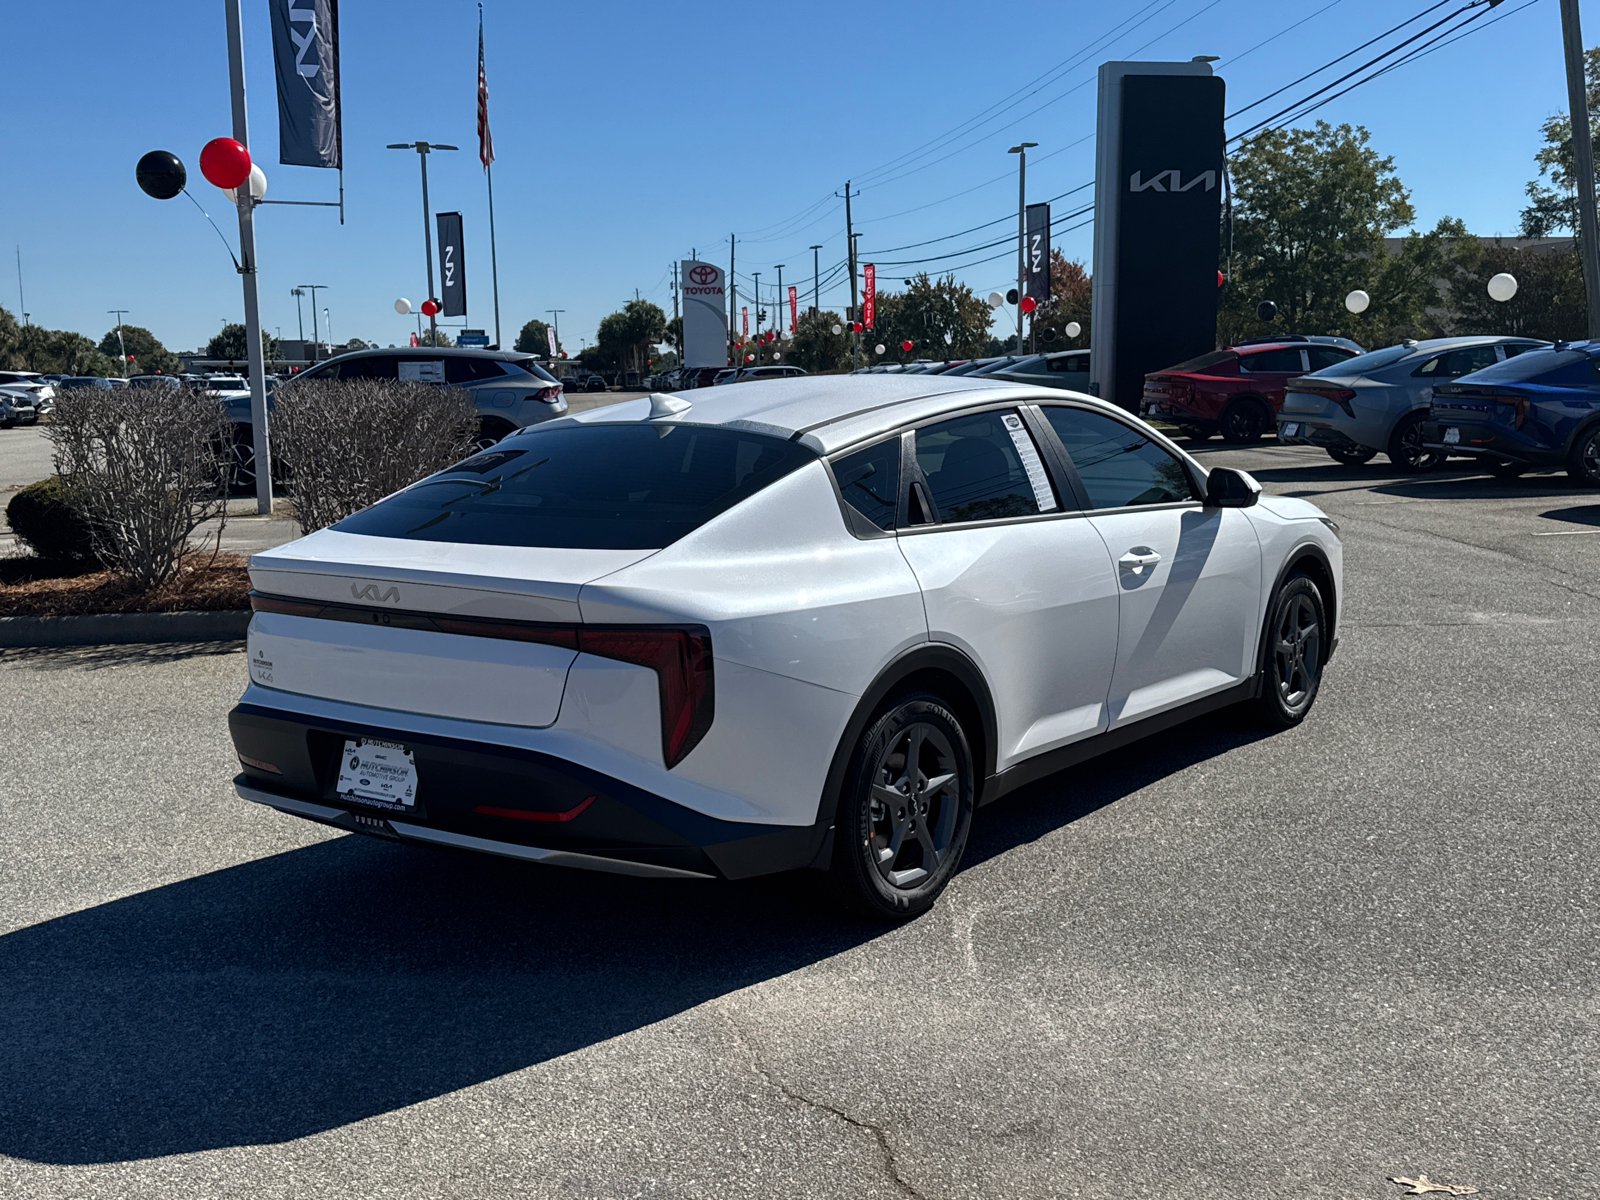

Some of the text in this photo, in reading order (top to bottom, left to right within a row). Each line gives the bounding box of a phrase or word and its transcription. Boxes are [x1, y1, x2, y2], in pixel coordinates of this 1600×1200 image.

[1130, 170, 1216, 192] KIA
[684, 287, 723, 295] TOYOTA
[350, 582, 401, 603] KIA
[367, 739, 405, 750] HUTCHINSON
[360, 763, 409, 777] HUTCHINSON
[360, 770, 389, 780] AUTOMOTIVE
[389, 775, 405, 783] GROUP
